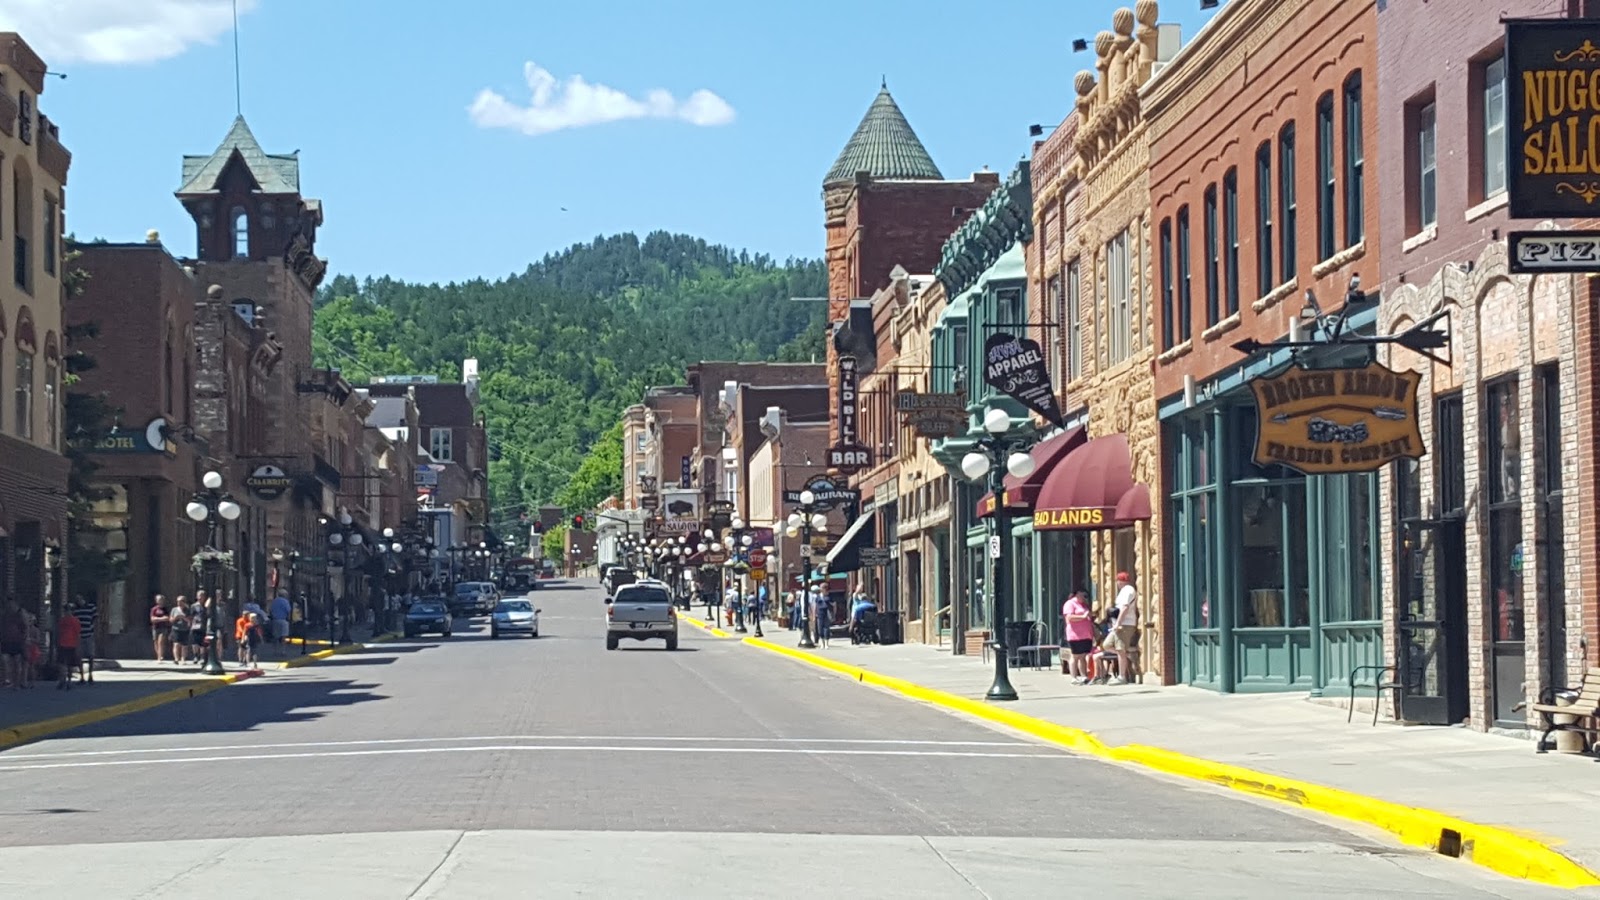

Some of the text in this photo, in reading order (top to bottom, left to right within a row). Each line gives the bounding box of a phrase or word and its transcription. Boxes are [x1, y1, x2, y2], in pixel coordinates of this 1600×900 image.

[1520, 241, 1600, 262] PIZ
[988, 350, 1042, 379] APPAREL
[1260, 370, 1411, 409] BROKEN ARROW
[842, 361, 854, 445] WILD BILL
[832, 451, 868, 465] BAR
[1266, 434, 1411, 465] TRADING COMPANY
[788, 491, 856, 501] REAURANT
[1051, 509, 1103, 525] LANDS
[666, 522, 698, 531] SALOON
[750, 554, 766, 562] STOP
